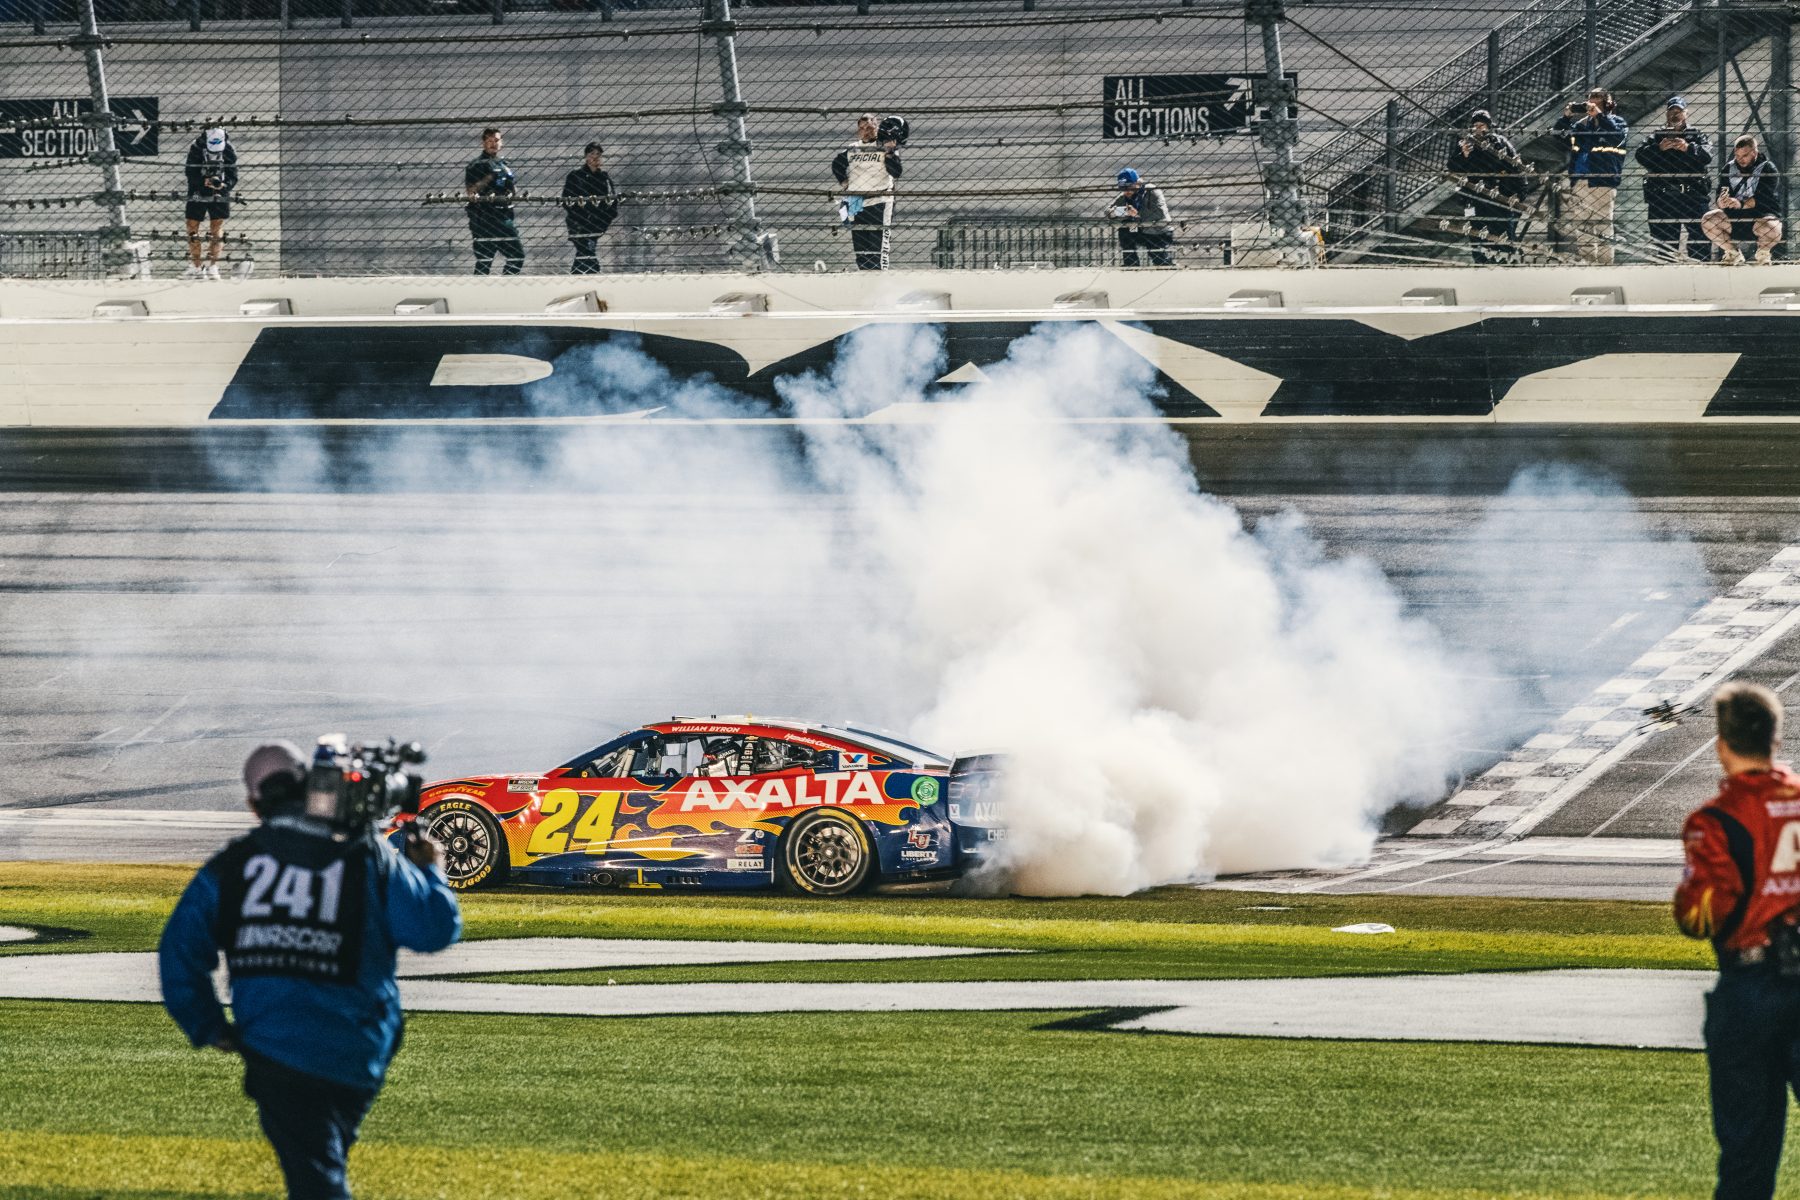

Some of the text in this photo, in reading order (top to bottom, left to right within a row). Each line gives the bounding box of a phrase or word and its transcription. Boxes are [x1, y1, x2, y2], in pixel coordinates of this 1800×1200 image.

[1115, 79, 1149, 106] ALL
[1113, 107, 1210, 136] SECTIONS
[21, 129, 99, 156] SECTION
[671, 725, 741, 733] WILLIAM BYRON
[428, 786, 487, 798] GOODYEAR
[680, 771, 885, 812] AXALTA
[440, 802, 471, 812] EAGLE
[526, 787, 621, 856] 24
[901, 850, 937, 858] LIBERTY
[242, 854, 344, 923] 241
[447, 864, 492, 889] GOODYE
